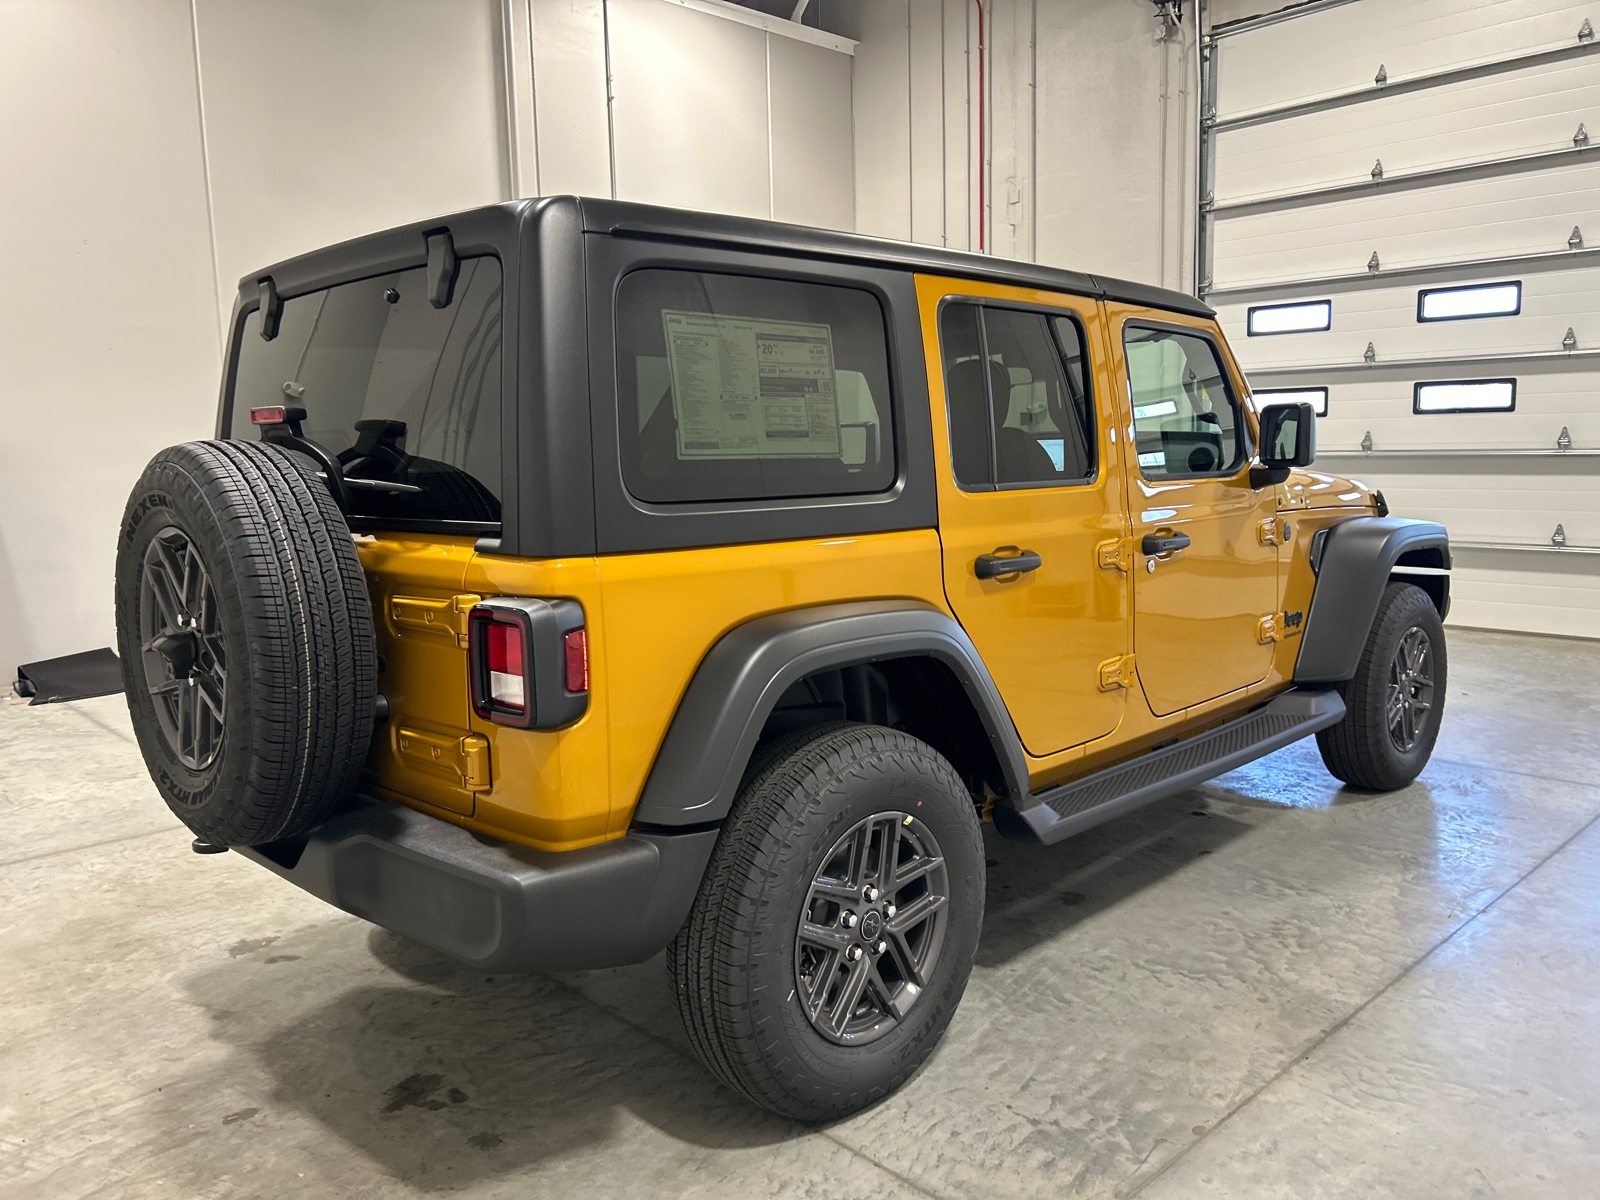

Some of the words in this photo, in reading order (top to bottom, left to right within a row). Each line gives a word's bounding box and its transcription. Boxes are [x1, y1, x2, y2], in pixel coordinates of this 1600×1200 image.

[762, 343, 773, 354] 20
[126, 494, 169, 544] NEXEN
[1284, 610, 1303, 629] Jeep
